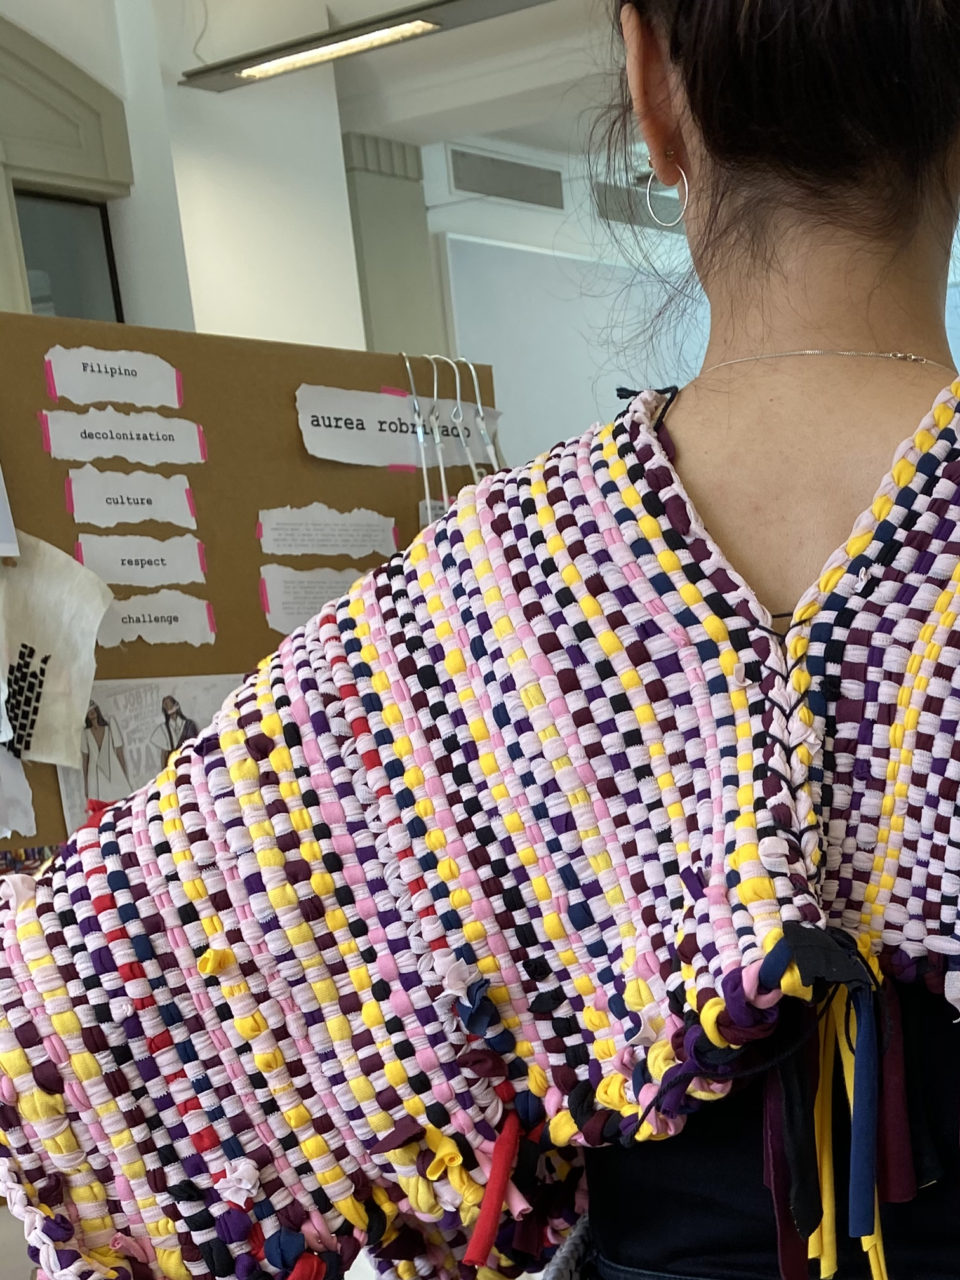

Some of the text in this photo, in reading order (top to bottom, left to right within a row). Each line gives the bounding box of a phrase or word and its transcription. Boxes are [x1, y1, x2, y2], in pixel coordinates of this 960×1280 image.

[82, 362, 138, 377] Filipino
[311, 413, 472, 438] aurea robriado
[80, 429, 175, 442] decolonization
[105, 495, 153, 506] culture
[120, 557, 167, 568] respect
[121, 613, 179, 625] challenge
